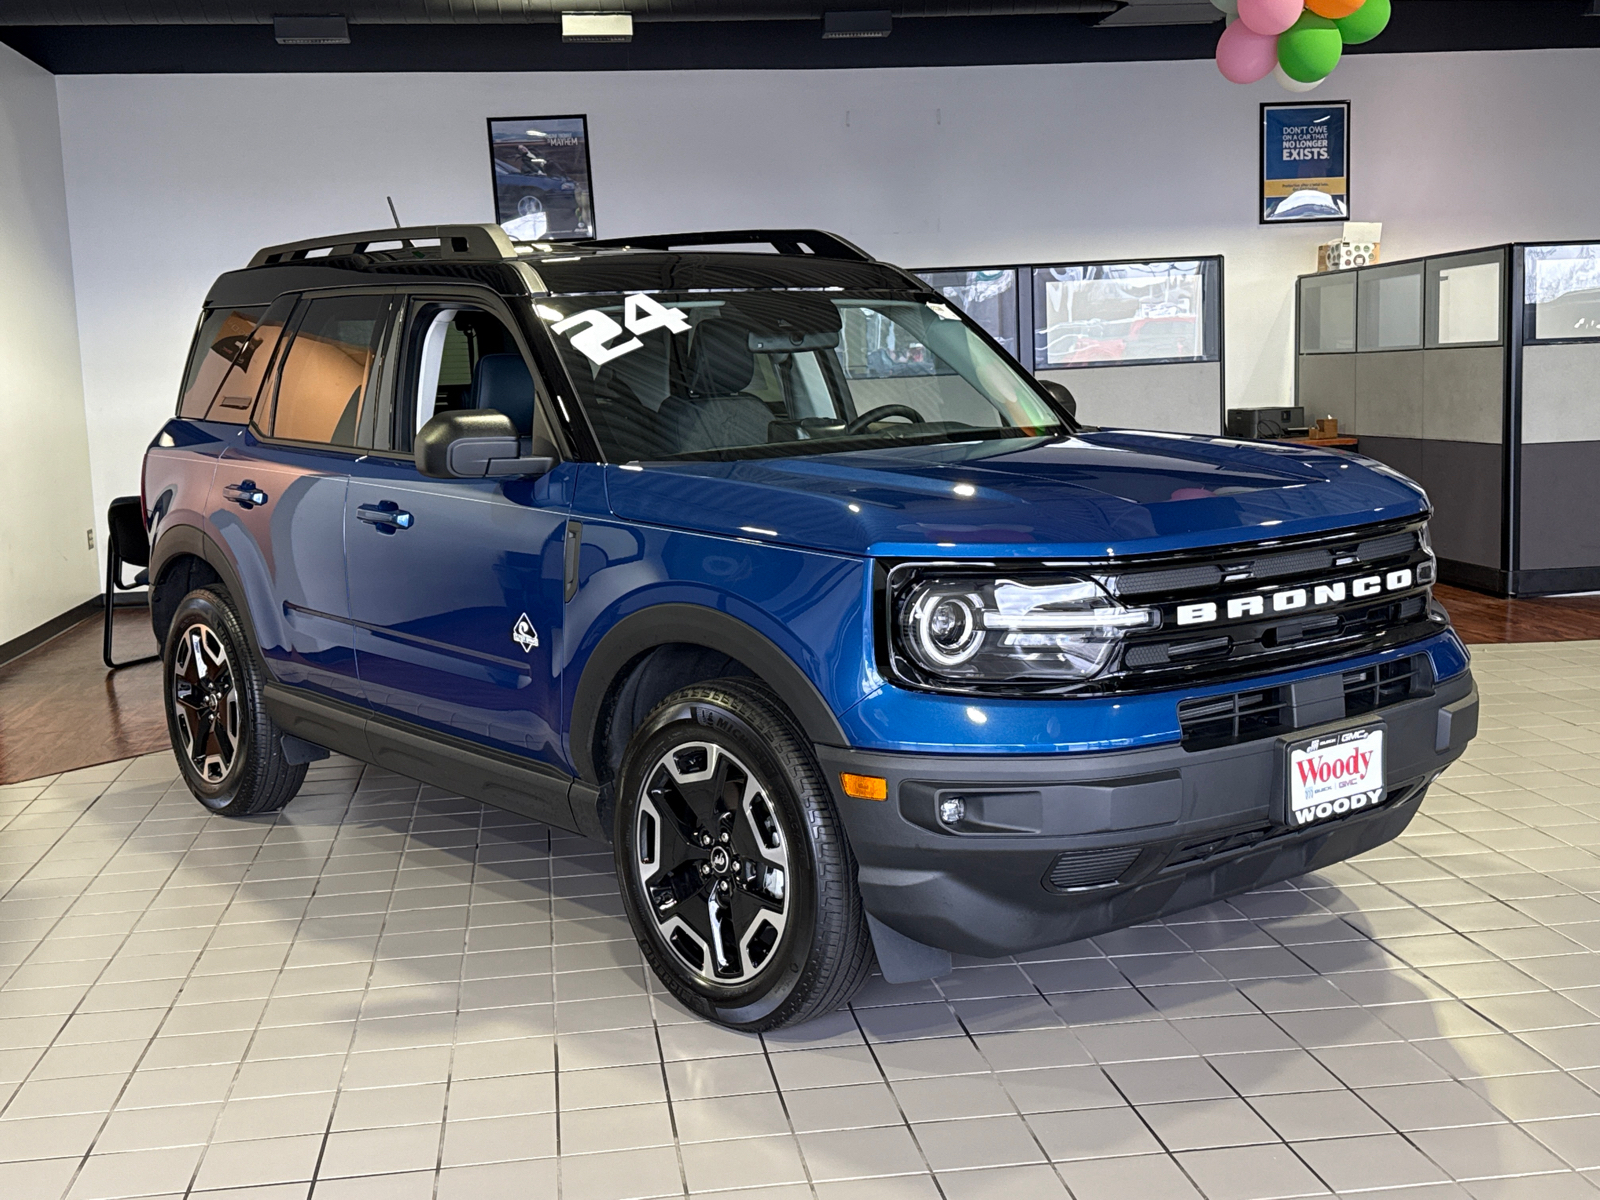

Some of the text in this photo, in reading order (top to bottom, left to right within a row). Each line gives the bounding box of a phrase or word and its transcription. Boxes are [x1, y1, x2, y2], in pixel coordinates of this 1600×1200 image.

[1283, 125, 1327, 134] DON'T OWE
[550, 137, 578, 147] MAYHEM
[1282, 139, 1328, 148] NO LONGER
[551, 292, 692, 366] 24
[1176, 568, 1412, 626] BRONCO
[1341, 729, 1366, 742] GMC
[1296, 747, 1374, 788] Woody
[1314, 778, 1358, 794] BUICK GMC
[1295, 788, 1383, 825] WOODY
